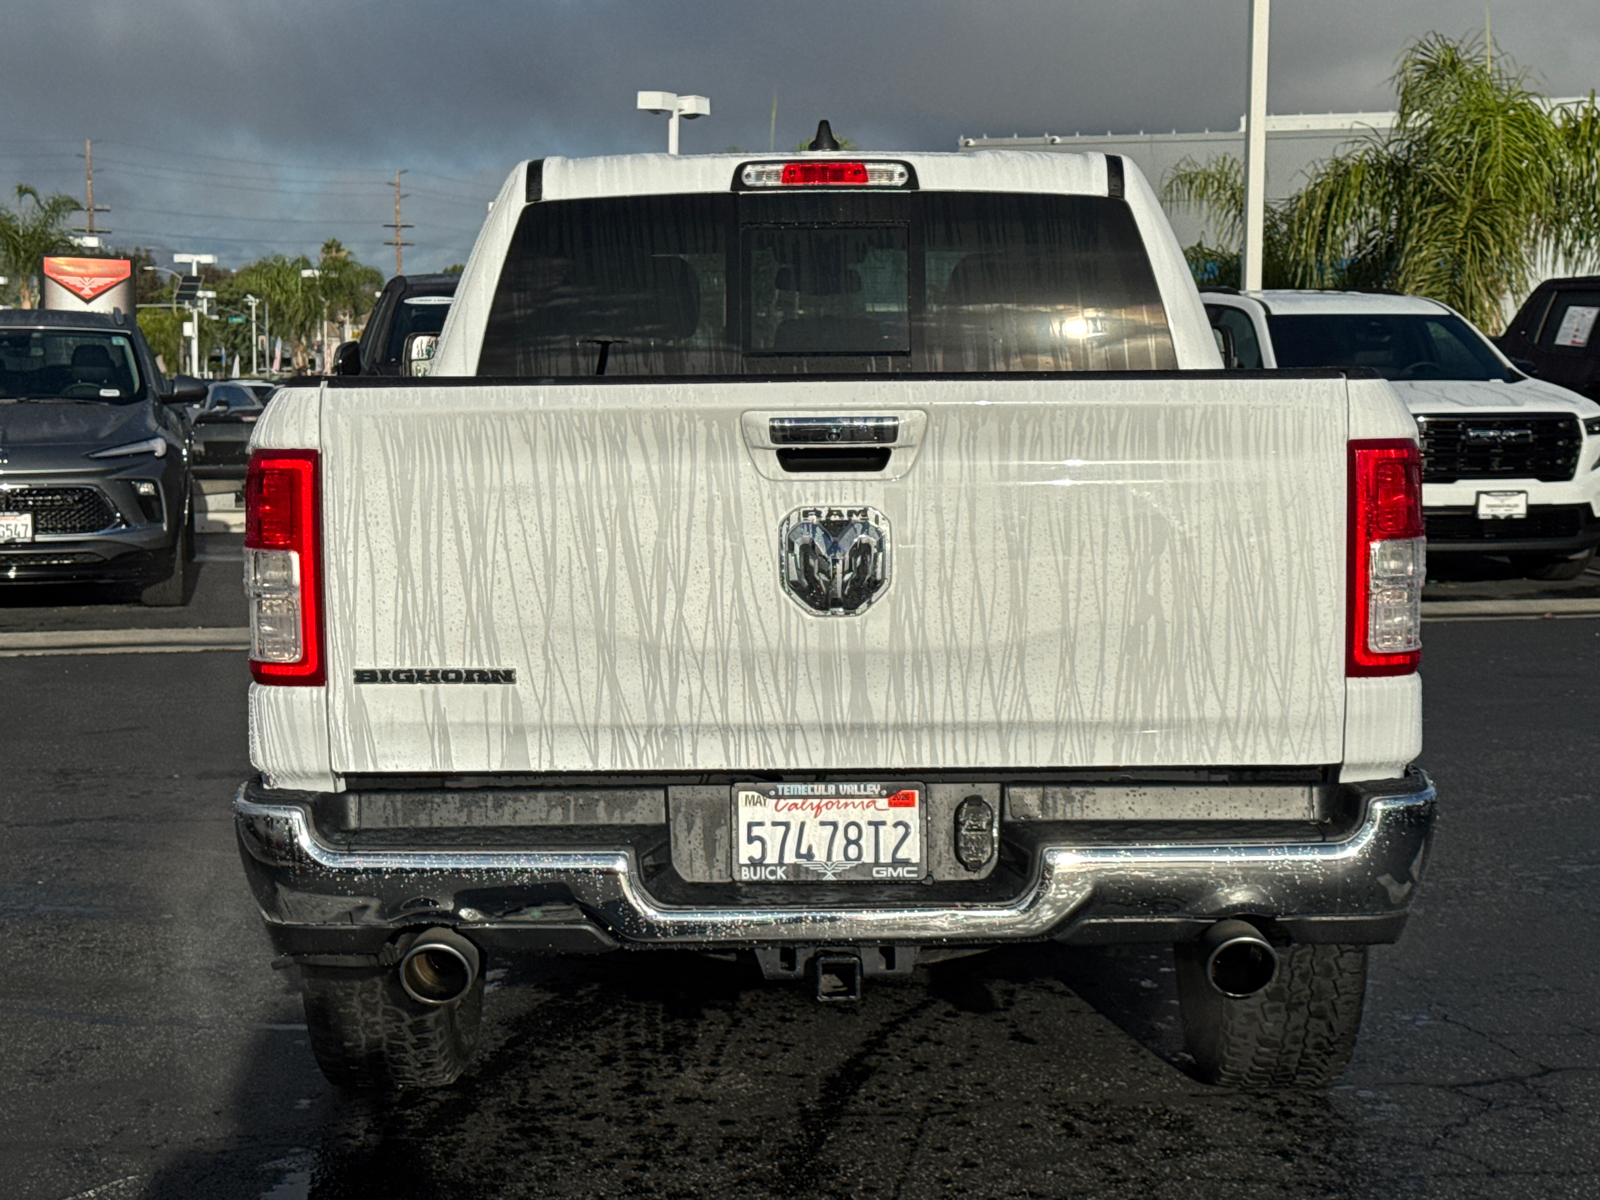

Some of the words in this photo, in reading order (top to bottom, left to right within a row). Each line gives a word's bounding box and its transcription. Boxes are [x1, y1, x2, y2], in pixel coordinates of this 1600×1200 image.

[802, 509, 869, 519] RAM
[354, 668, 516, 684] BIGHORN
[777, 784, 836, 796] TEMECULA
[839, 784, 881, 795] VALLEY
[745, 794, 767, 807] MAY
[774, 799, 890, 818] California
[747, 820, 912, 863] 57478T2
[741, 866, 787, 880] BUICK
[872, 866, 918, 878] GMC
